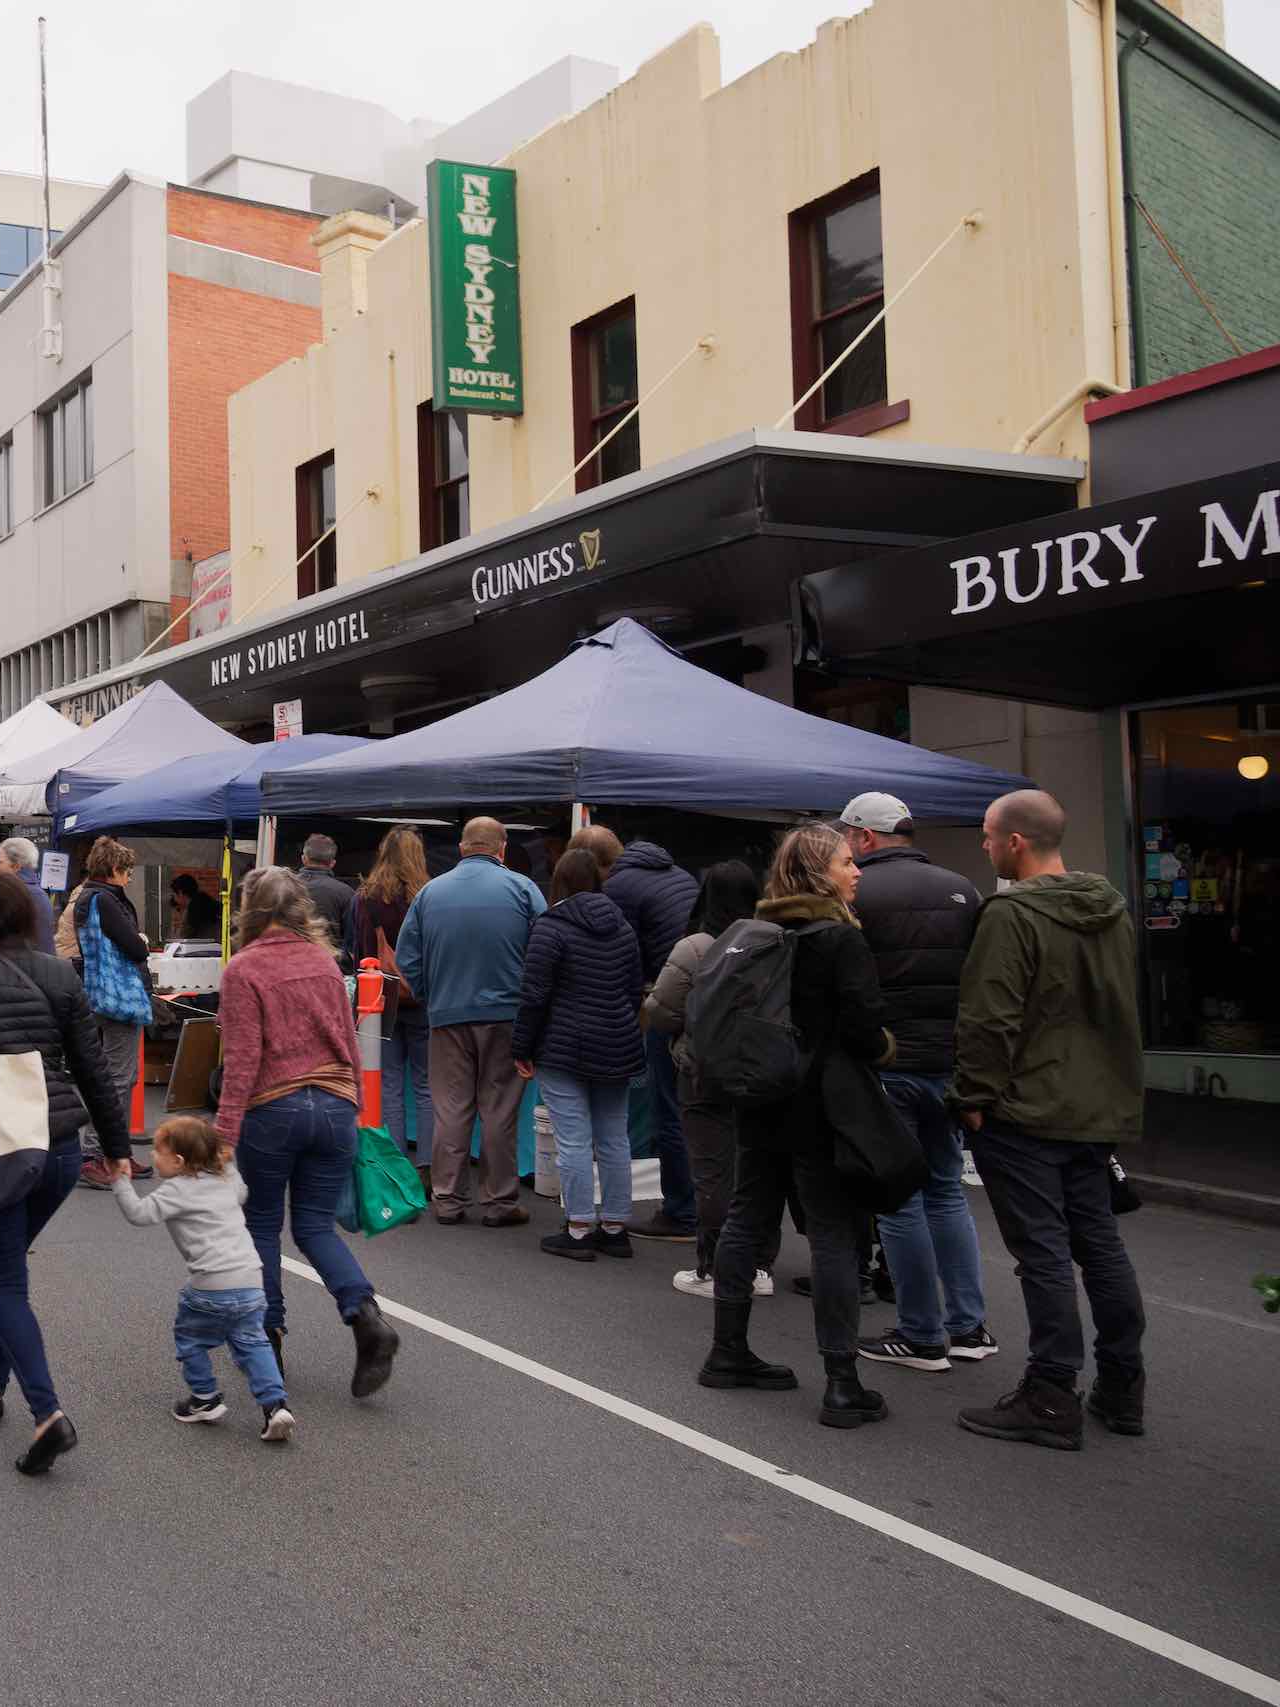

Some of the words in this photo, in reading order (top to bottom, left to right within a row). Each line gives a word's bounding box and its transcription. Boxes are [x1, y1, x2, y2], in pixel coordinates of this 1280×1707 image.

[457, 173, 496, 237] NEW
[463, 244, 496, 364] SYDNEY
[448, 367, 516, 389] HOTEL
[471, 542, 575, 604] GUINNESS
[949, 515, 1158, 616] BURY
[211, 651, 241, 687] NEW
[247, 629, 307, 675] SYDNEY
[315, 609, 369, 654] HOTEL
